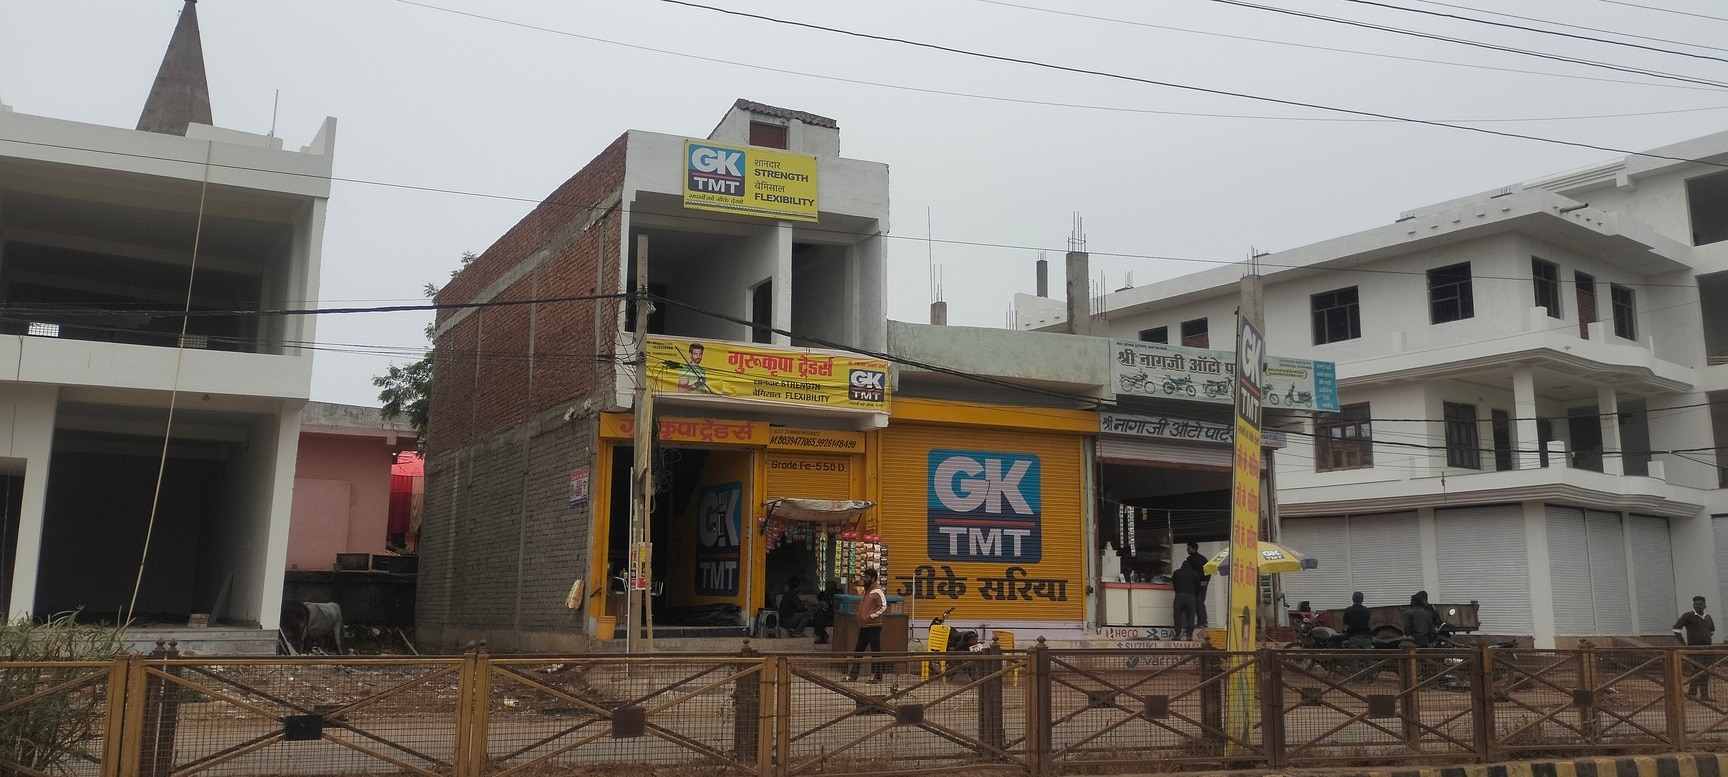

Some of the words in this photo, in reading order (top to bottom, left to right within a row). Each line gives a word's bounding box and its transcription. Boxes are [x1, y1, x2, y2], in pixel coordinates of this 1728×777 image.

[691, 147, 742, 177] GK
[754, 159, 781, 169] शानदार
[693, 177, 740, 194] TMT
[754, 169, 809, 182] STRENGTH
[754, 180, 786, 193] बेमिसाल
[754, 193, 815, 207] FLEXIBILITY
[797, 353, 835, 378] ट्रेडर्स
[1118, 349, 1136, 367] श्री
[1139, 354, 1186, 371] नागजी
[1189, 355, 1222, 375] ऑटो
[1241, 324, 1261, 390] GK
[781, 380, 820, 391] STRENGTH
[850, 370, 884, 390] GK
[752, 388, 781, 399] बेमिसाल
[785, 392, 830, 403] FLEXIBILITY
[852, 391, 882, 401] TMT
[1240, 386, 1260, 424] TMT
[699, 417, 756, 442] ट्रेडर्स
[1169, 420, 1203, 438] ऑटो
[771, 461, 797, 470] Grade
[799, 461, 836, 471] Fe-550
[838, 463, 845, 472] D
[934, 456, 1034, 515] GK
[700, 488, 740, 547] GK
[939, 526, 1031, 557] TMT
[700, 561, 737, 590] TMT
[895, 565, 968, 600] जीके
[976, 566, 1069, 602] सरिया
